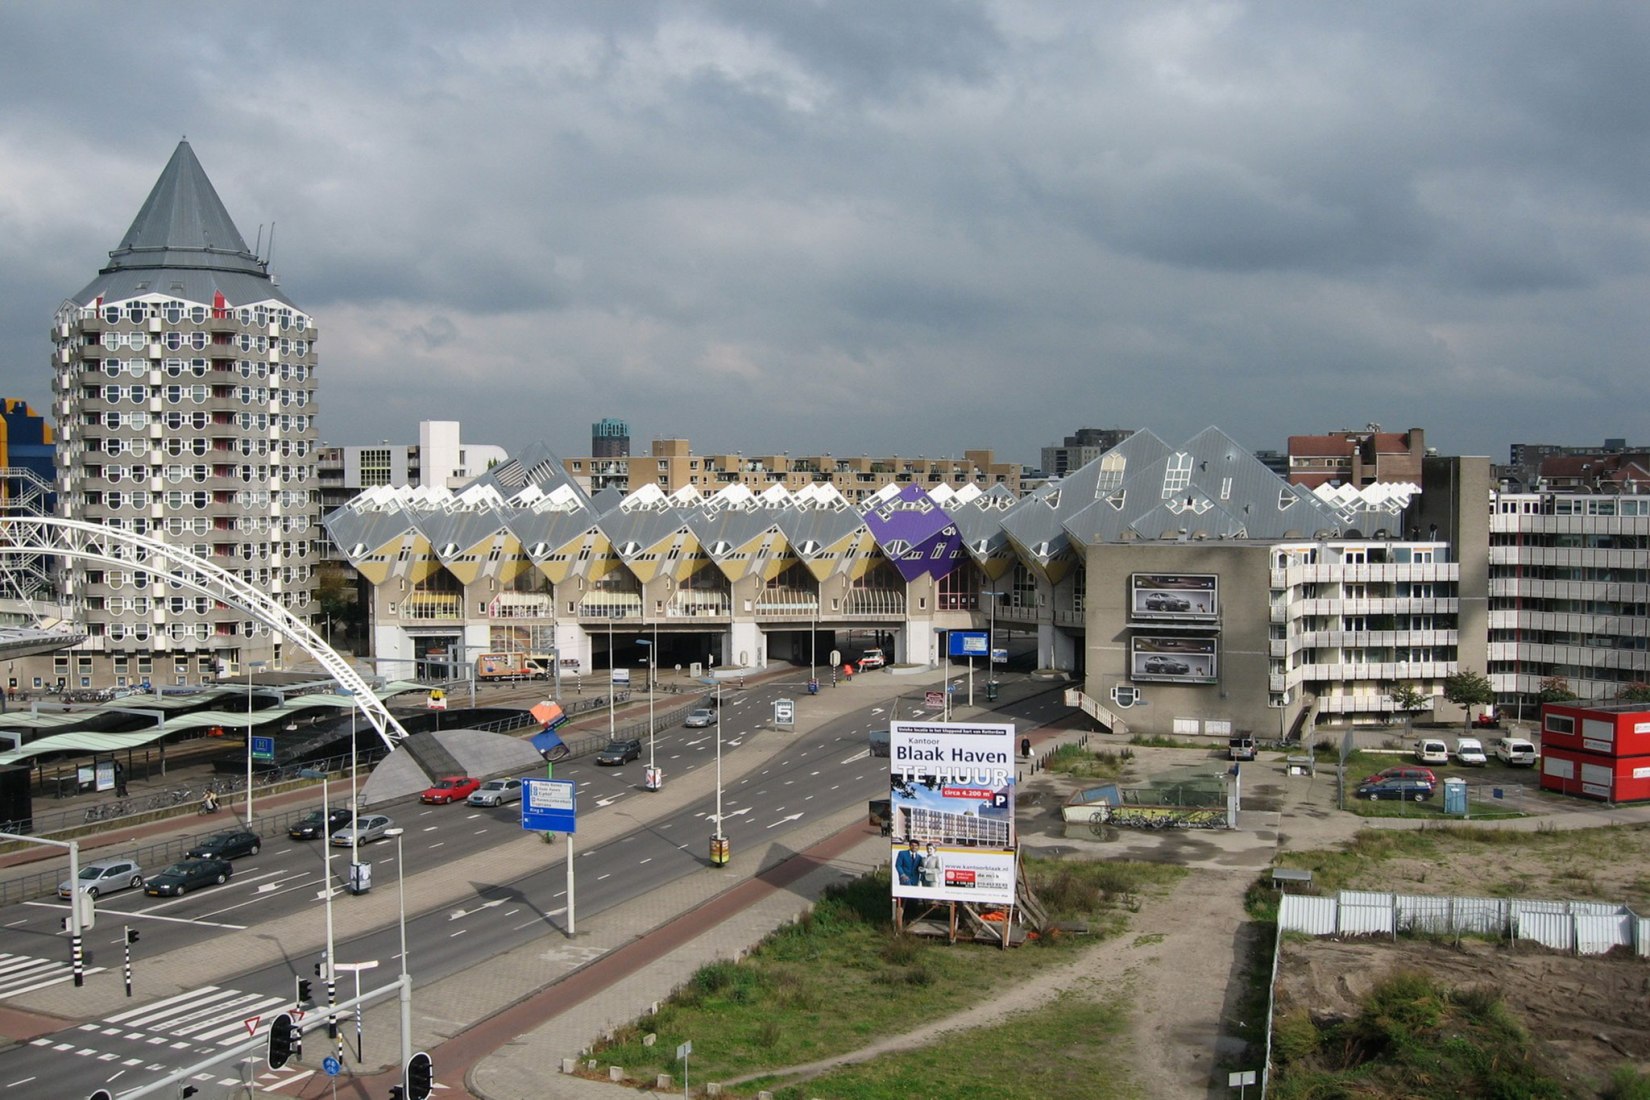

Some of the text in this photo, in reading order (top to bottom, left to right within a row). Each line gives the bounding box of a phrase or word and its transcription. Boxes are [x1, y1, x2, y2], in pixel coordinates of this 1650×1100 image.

[908, 737, 940, 745] Kantoor
[897, 746, 1006, 763] Blaak Haven
[898, 764, 1009, 787] TE HUUR
[995, 795, 1006, 807] P
